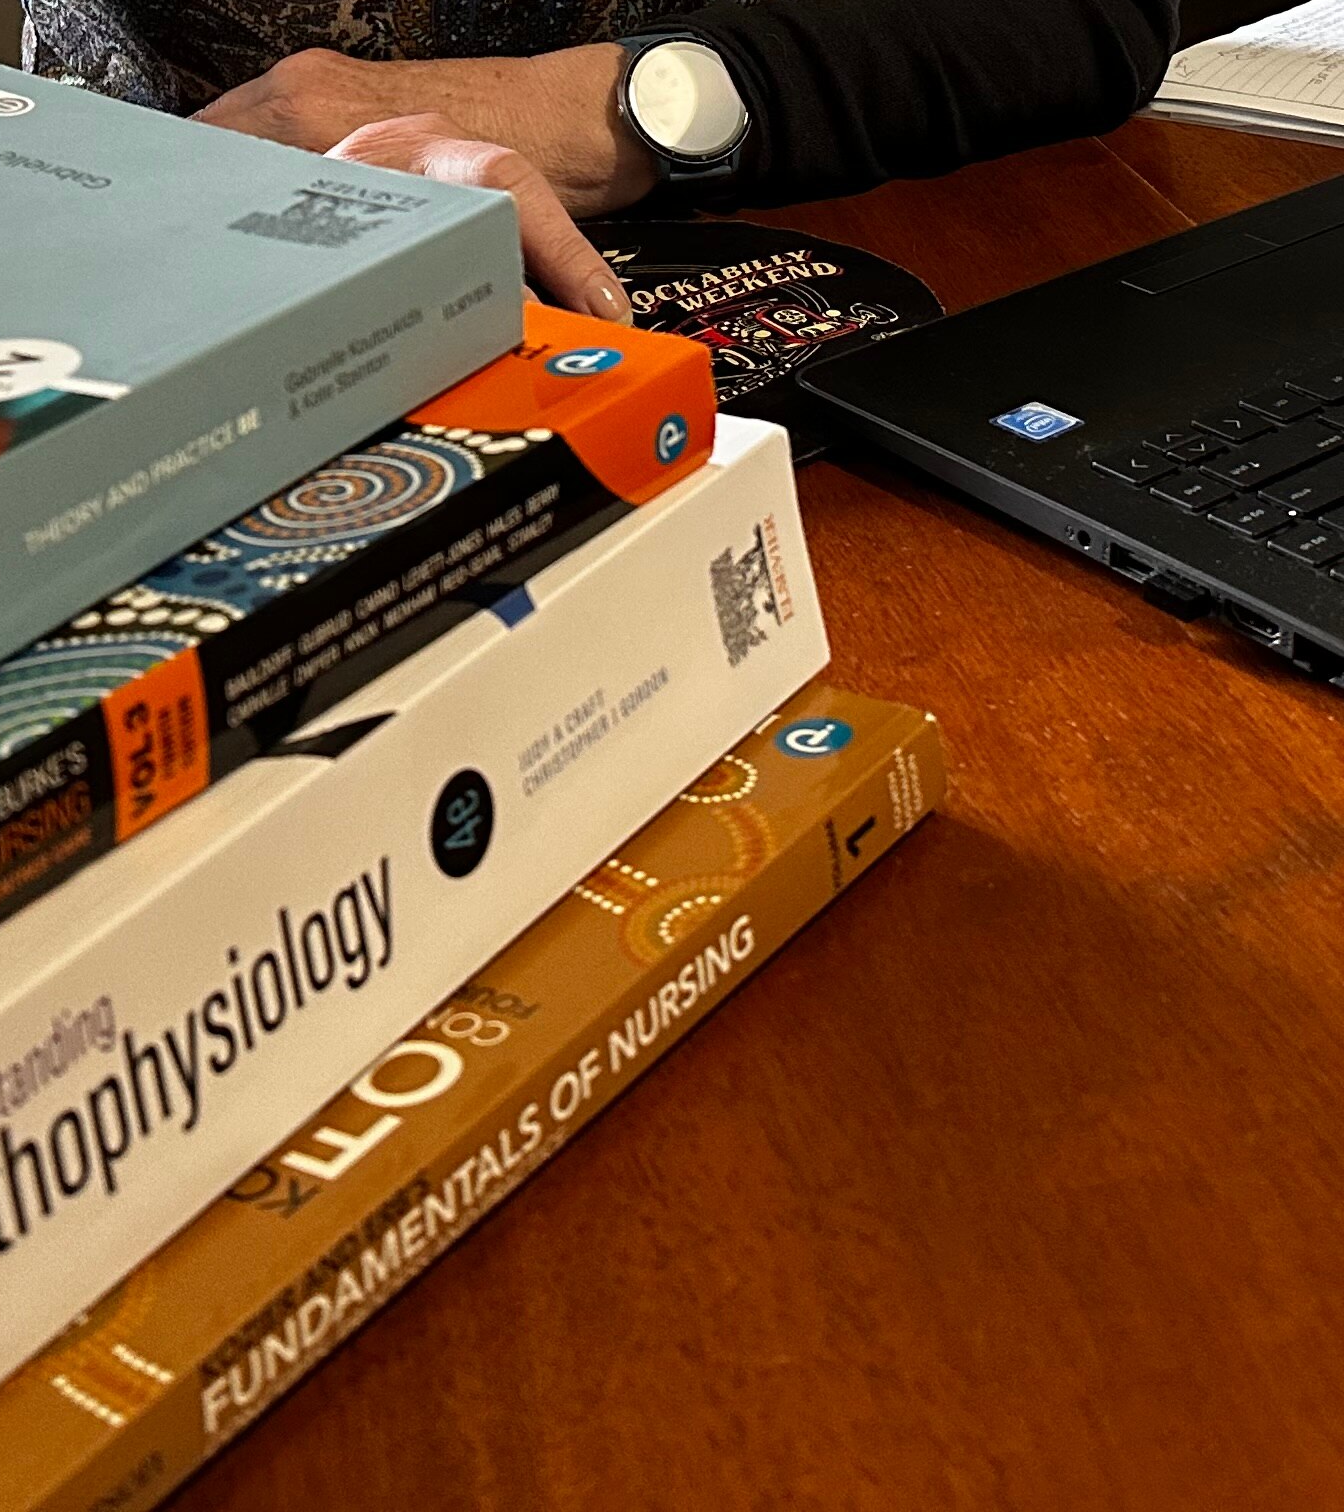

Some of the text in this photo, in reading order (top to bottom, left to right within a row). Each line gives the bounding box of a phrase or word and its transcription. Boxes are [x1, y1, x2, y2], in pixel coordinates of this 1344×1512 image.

[631, 249, 811, 315] OCKABILLY
[677, 262, 841, 313] WEEKEND
[23, 500, 102, 556] THEORY
[104, 468, 150, 518] AND
[148, 426, 236, 495] PRACTICE
[126, 733, 156, 820] VOL
[197, 914, 759, 1434] FUNDAMENTALS OF NURSING
